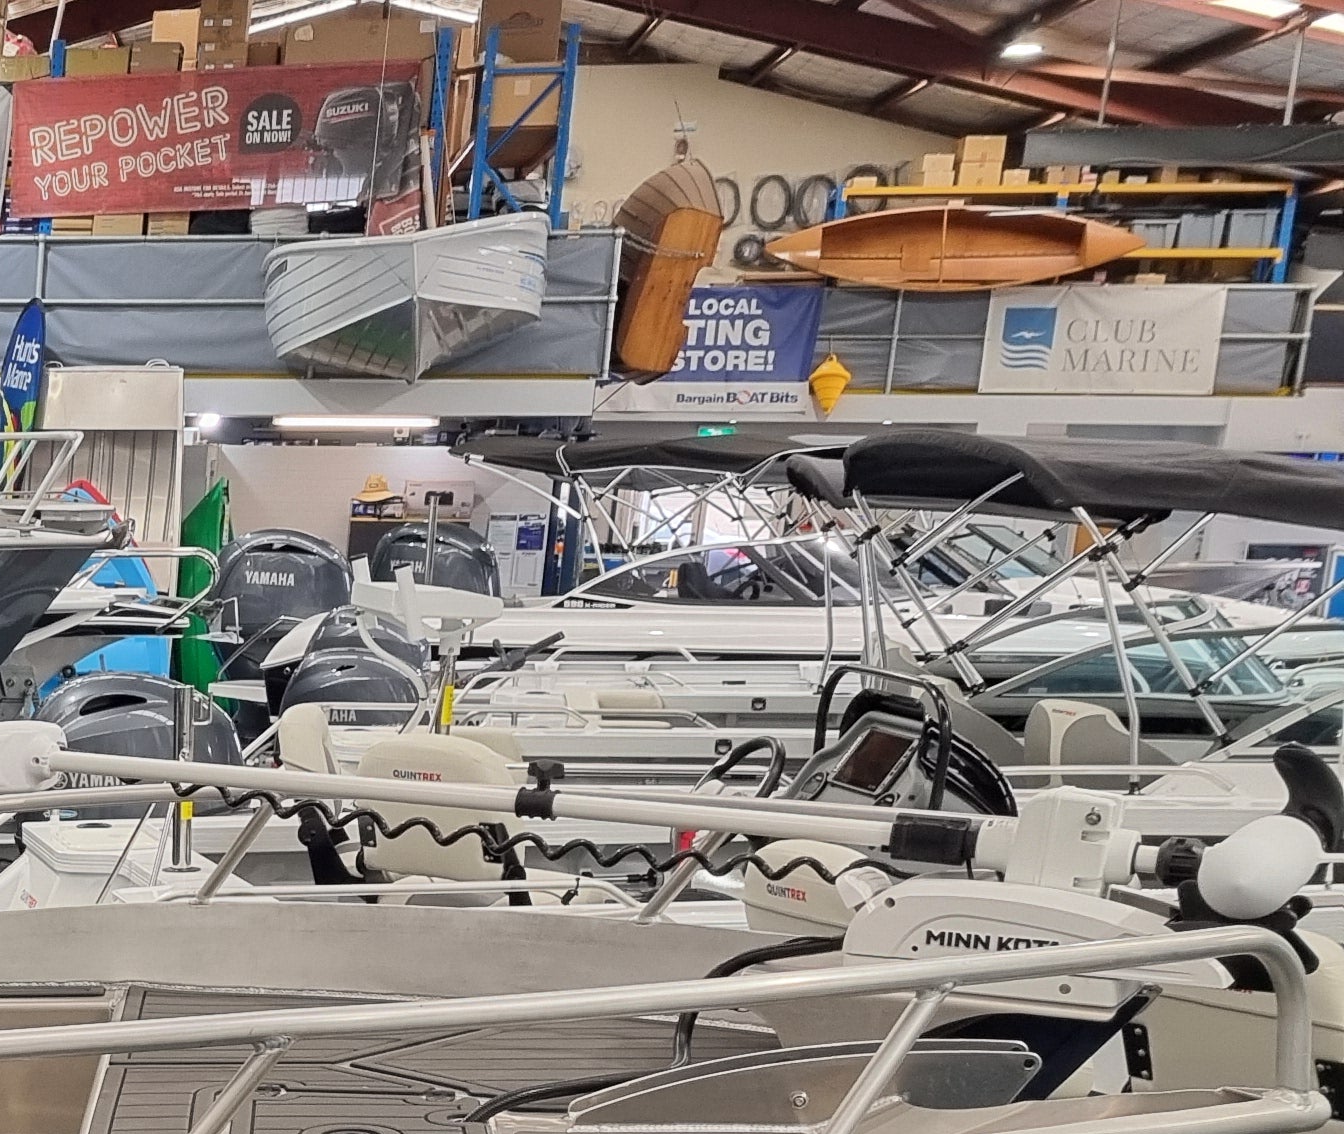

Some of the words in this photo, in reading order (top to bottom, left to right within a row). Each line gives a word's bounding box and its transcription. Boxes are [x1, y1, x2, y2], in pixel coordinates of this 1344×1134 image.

[246, 109, 292, 131] SALE
[325, 104, 369, 118] SUZUKI
[29, 87, 230, 167] REPOWER
[245, 132, 261, 145] ON
[262, 129, 292, 143] NOW!
[34, 161, 109, 201] YOUR
[118, 134, 231, 182] POCKET
[688, 298, 762, 316] LOCAL
[682, 319, 770, 346] TING
[1066, 318, 1156, 344] CLUB
[1061, 349, 1201, 373] MARINE
[676, 393, 725, 406] Bargain
[769, 391, 799, 404] Bits
[245, 570, 295, 587] YAMAHA
[330, 709, 357, 723] AHA
[392, 769, 442, 782] QUINTREX
[766, 883, 807, 903] QUINTREX
[925, 929, 991, 951] MINN
[996, 936, 1061, 951] KOT
